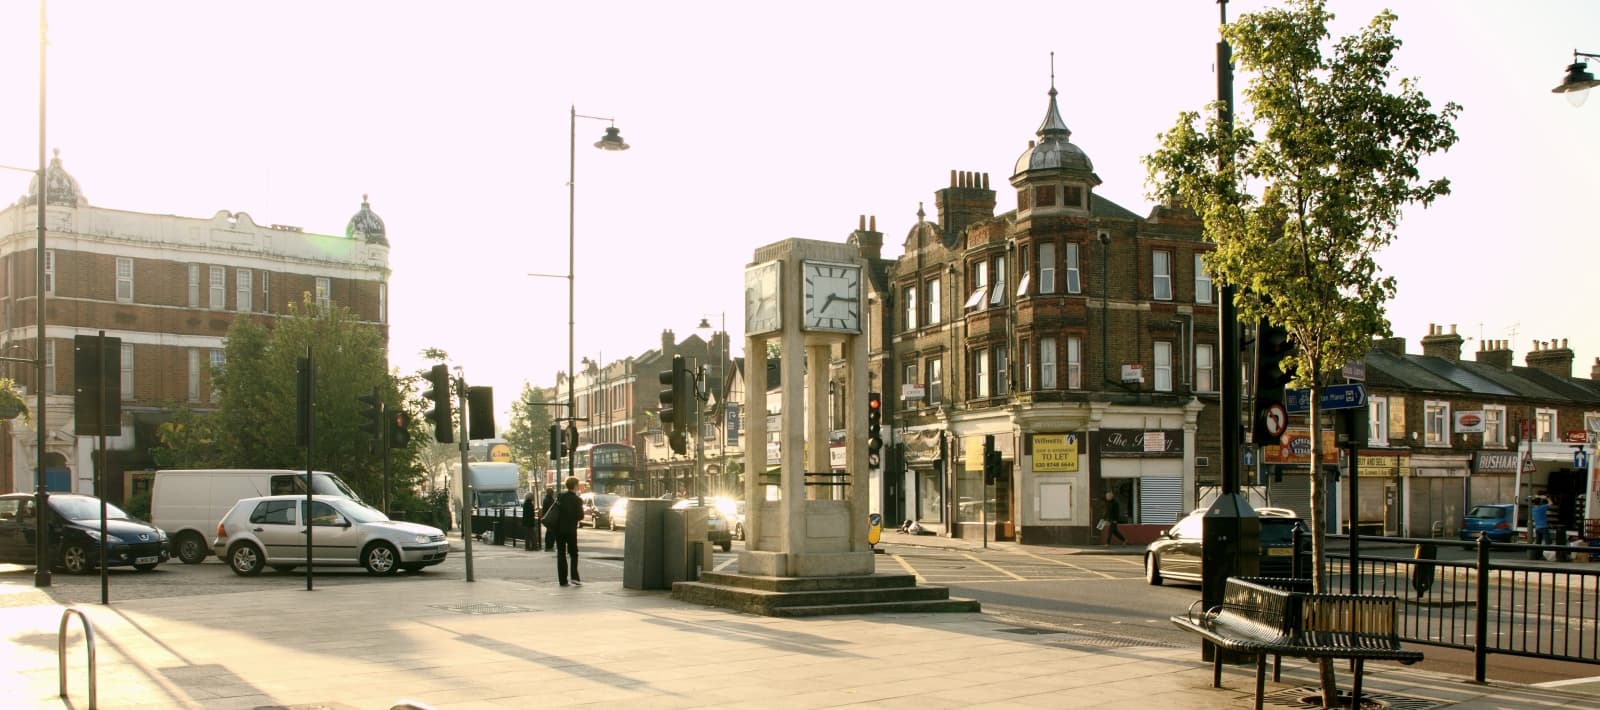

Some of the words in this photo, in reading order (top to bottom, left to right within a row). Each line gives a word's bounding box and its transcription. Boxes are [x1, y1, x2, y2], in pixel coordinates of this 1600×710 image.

[1106, 432, 1128, 447] The
[1367, 457, 1376, 466] AND
[1376, 457, 1386, 466] SELL
